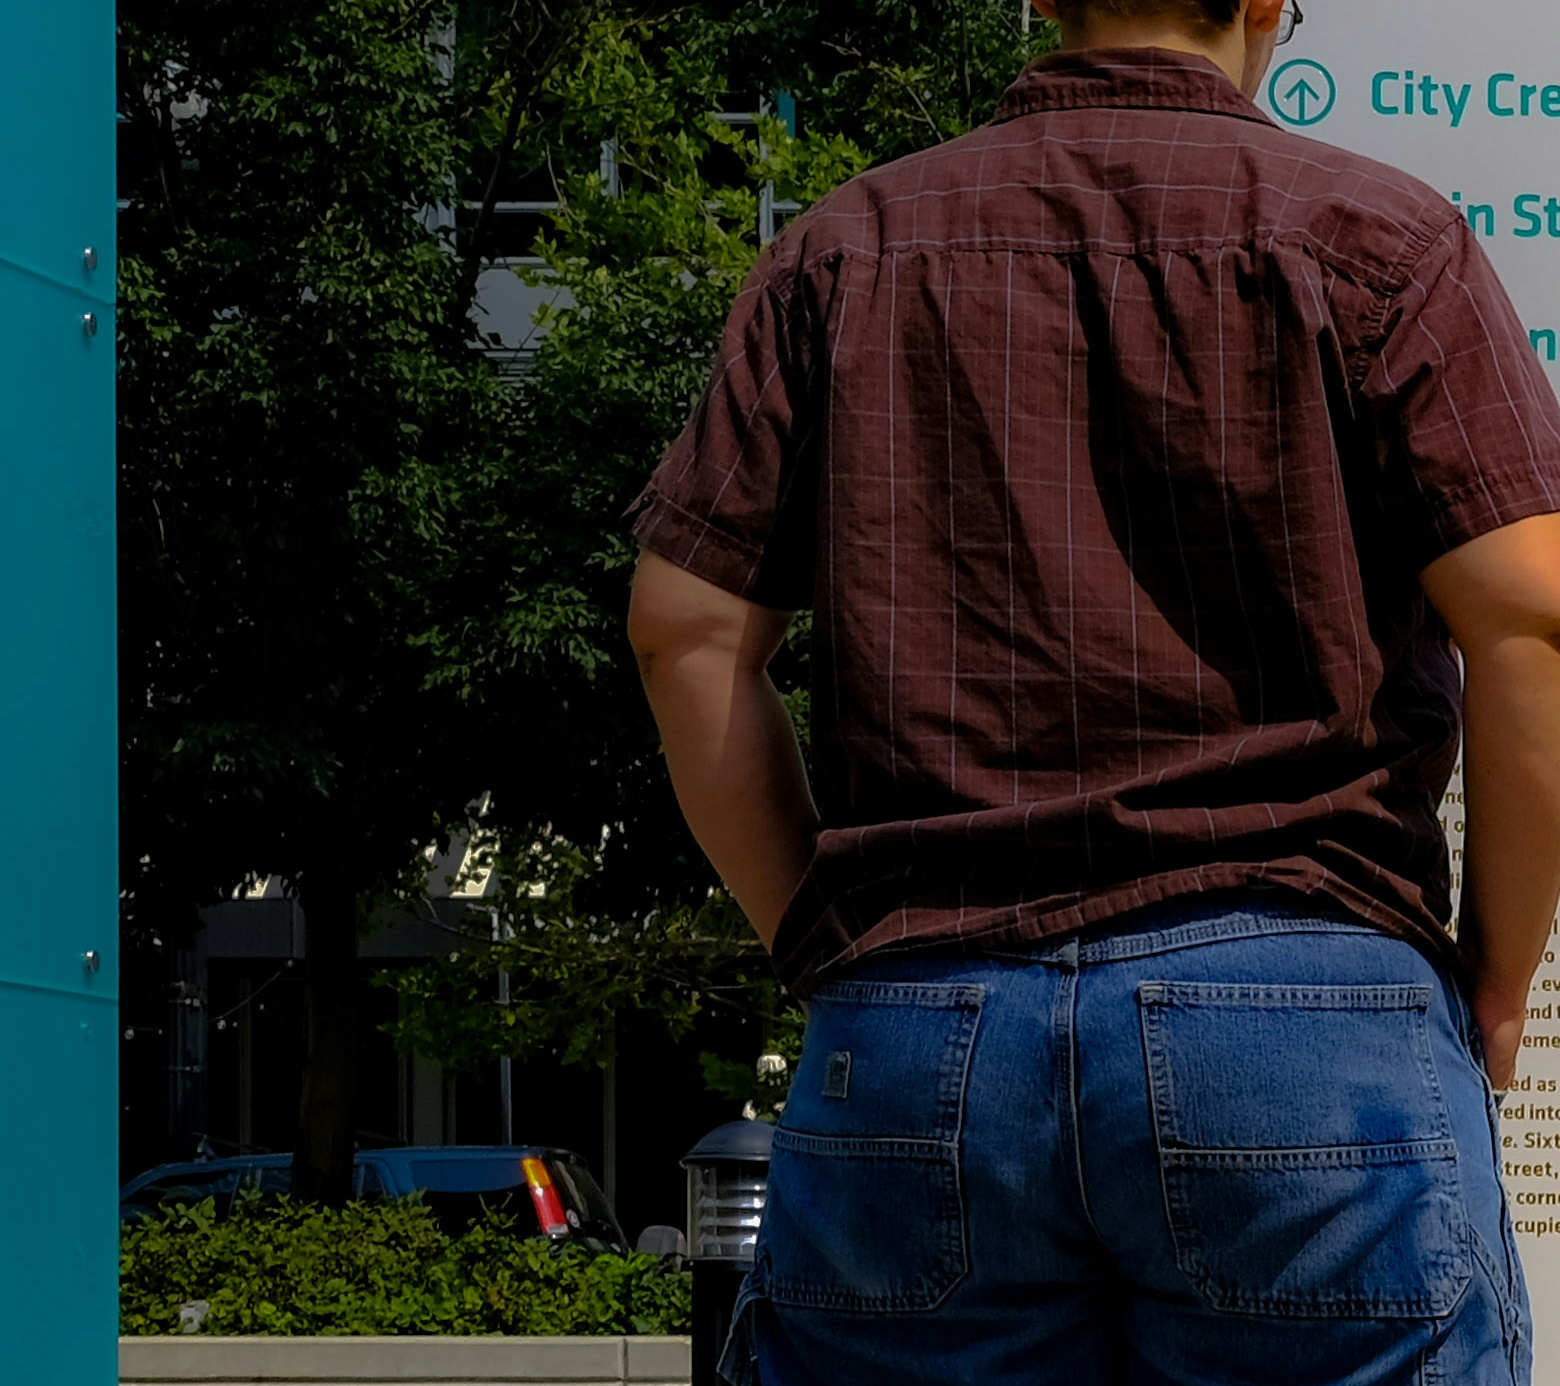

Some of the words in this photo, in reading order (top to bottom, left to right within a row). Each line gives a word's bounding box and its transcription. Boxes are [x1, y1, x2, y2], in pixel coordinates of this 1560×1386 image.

[1370, 70, 1472, 128] City
[1537, 1079, 1557, 1092] as
[1504, 1161, 1559, 1180] treet,
